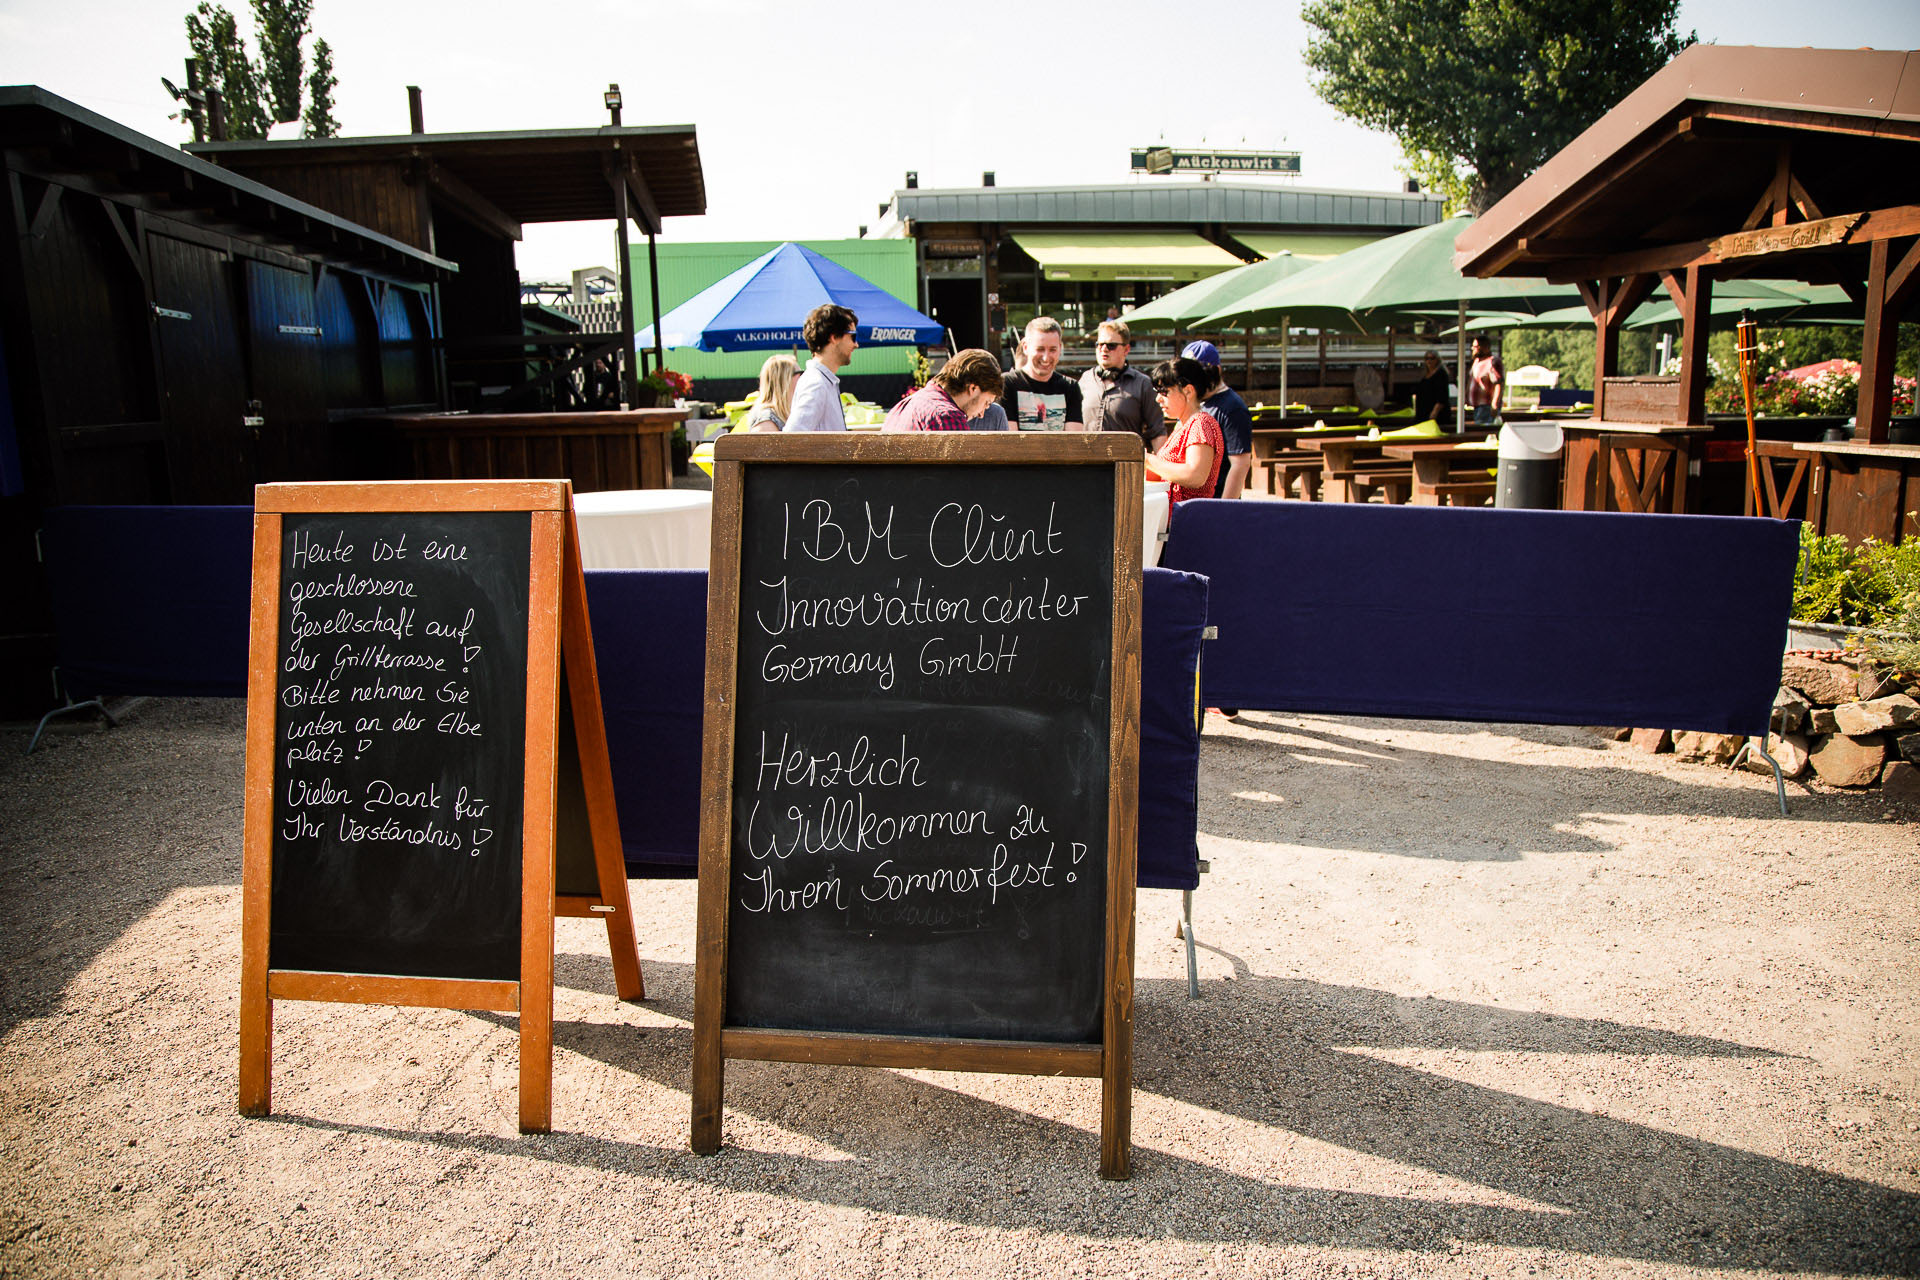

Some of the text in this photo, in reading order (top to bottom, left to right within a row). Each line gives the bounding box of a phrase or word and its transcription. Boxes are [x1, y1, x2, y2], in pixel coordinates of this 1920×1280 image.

[734, 331, 804, 342] ALKOHOLFR
[870, 326, 916, 341] ERDINGER
[292, 530, 469, 569] Heute ist eine
[783, 499, 1063, 568] IBM Client
[289, 573, 418, 613] geschlossene
[290, 606, 475, 652] Gesellschaft auf
[284, 647, 321, 672] der
[762, 644, 895, 691] Germany
[919, 633, 1019, 677] GmbH
[281, 676, 470, 708] Bitte nehmen Sie
[287, 710, 482, 740] unten an der Elbe
[756, 730, 927, 792] Herzlich
[288, 777, 353, 807] Vielen
[363, 779, 441, 812] Dank
[748, 791, 1050, 860] Willkommen zu
